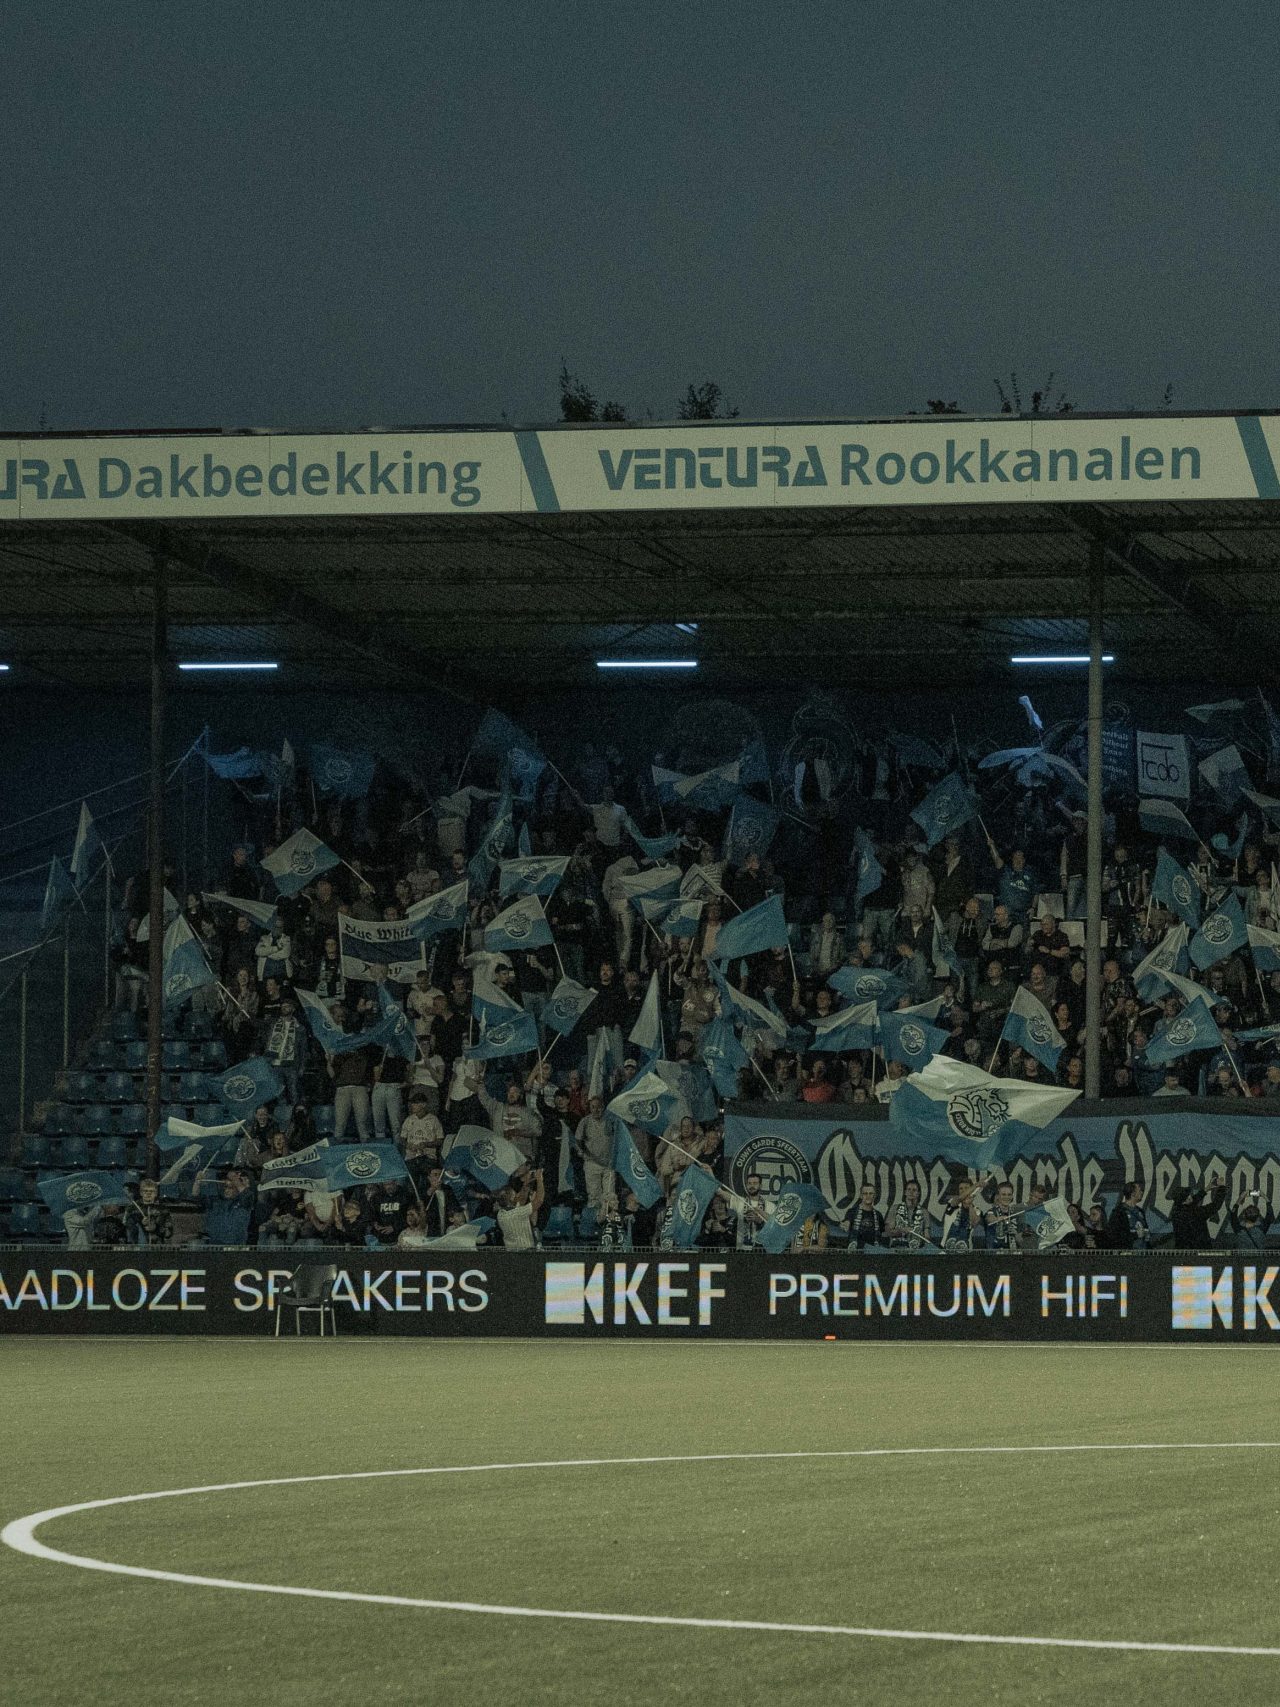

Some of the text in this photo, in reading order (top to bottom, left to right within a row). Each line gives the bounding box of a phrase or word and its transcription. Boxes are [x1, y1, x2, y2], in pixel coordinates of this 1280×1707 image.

[98, 450, 481, 507] Dakbedekking
[598, 436, 1201, 491] VENTURA Rookkanalen
[376, 926, 413, 940] Whit
[751, 1138, 775, 1151] GARDE
[233, 1268, 489, 1312] SPAKERS
[613, 1262, 727, 1326] KEF
[768, 1273, 1011, 1317] PREMIUM
[1041, 1275, 1128, 1318] HIFI
